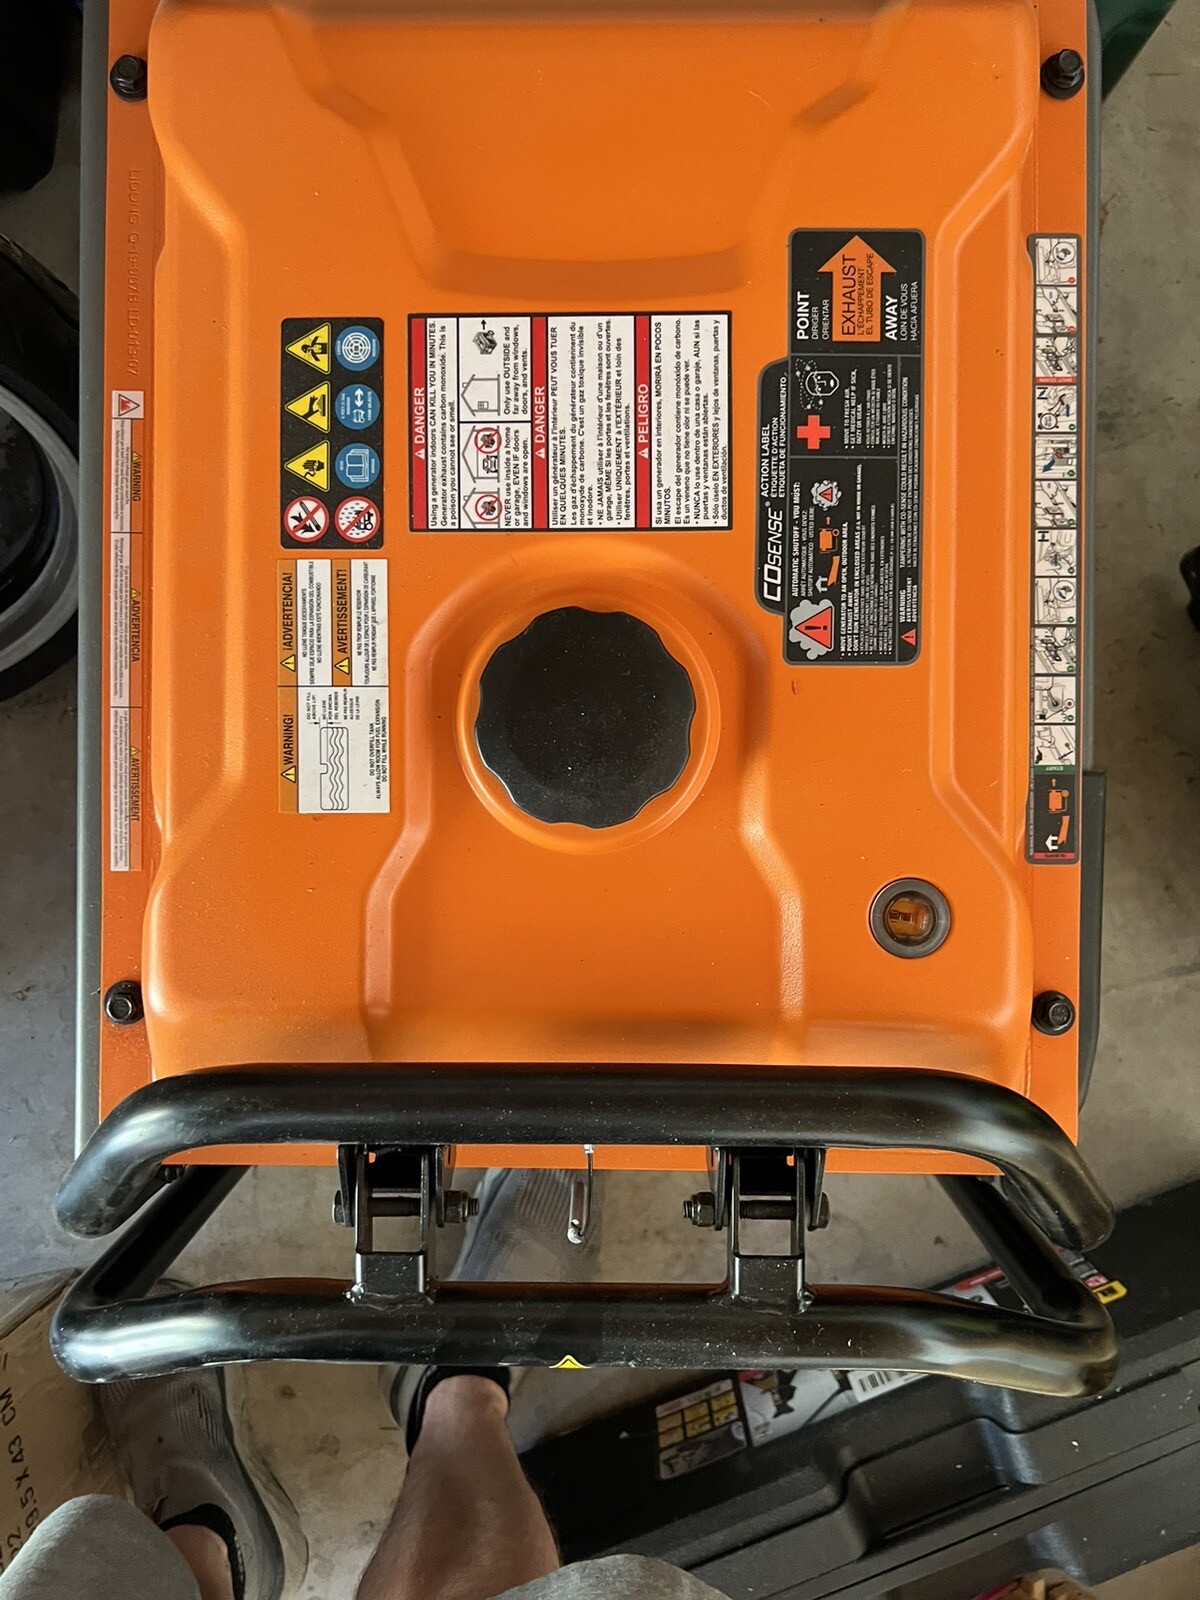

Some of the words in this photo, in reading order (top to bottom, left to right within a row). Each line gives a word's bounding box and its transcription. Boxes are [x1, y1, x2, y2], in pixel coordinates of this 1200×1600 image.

[866, 253, 874, 286] ESCAPE
[841, 254, 856, 335] EXHAUST
[856, 267, 865, 336] L'ÉCHAPPEMENT
[866, 287, 874, 299] DE
[900, 283, 908, 307] VOUS
[910, 281, 918, 314] AFUERA
[796, 291, 810, 340] POINT
[811, 306, 819, 340] DIRIGER
[822, 299, 830, 340] ORIENTAR
[865, 300, 873, 323] TUBO
[885, 295, 898, 341] AWAY
[900, 308, 908, 320] DE
[428, 321, 436, 359] MINUTES.
[550, 327, 558, 349] TUER
[569, 322, 576, 332] du
[654, 321, 662, 351] POCOS
[866, 325, 873, 335] EL
[429, 360, 436, 369] IN
[550, 350, 558, 374] VOUS
[654, 352, 662, 364] EN
[674, 350, 681, 360] de
[513, 382, 521, 403] away
[550, 375, 558, 397] PEUT
[414, 387, 425, 444] DANGER
[503, 396, 512, 415] Only
[534, 386, 545, 443] DANGER
[637, 383, 649, 443] PELIGRO
[779, 377, 787, 447] FUNCIONAMIENTO
[449, 424, 455, 433] or
[512, 429, 520, 452] doors
[570, 423, 577, 434] du
[761, 424, 770, 456] LABEL
[656, 438, 662, 448] en
[675, 434, 683, 474] generador
[779, 448, 786, 459] DE
[512, 454, 519, 462] IF
[655, 449, 664, 488] generador
[132, 462, 141, 502] WARNING
[430, 459, 439, 496] generator
[512, 463, 520, 486] EVEN
[674, 474, 682, 487] del
[760, 458, 769, 497] ACTION
[514, 487, 522, 517] garage,
[521, 475, 529, 510] windows
[553, 486, 558, 497] un
[656, 489, 662, 500] un
[430, 504, 439, 527] Using
[440, 488, 448, 527] Generator
[559, 514, 566, 526] EN
[655, 516, 662, 525] Si
[674, 516, 682, 525] El
[514, 518, 520, 527] or
[791, 558, 799, 597] AUTOMATIC
[282, 572, 293, 651] ¡ADVERTENCIA!
[337, 569, 348, 654] AVERTISSEMENT!
[131, 599, 140, 662] ADVERTENCIA
[283, 714, 294, 765] WARNING!
[369, 768, 375, 776] DO
[131, 758, 140, 822] AVERTISSEMENT
[8, 1435, 24, 1464] 43
[15, 1466, 29, 1490] X
[20, 1486, 40, 1531] 9.5
